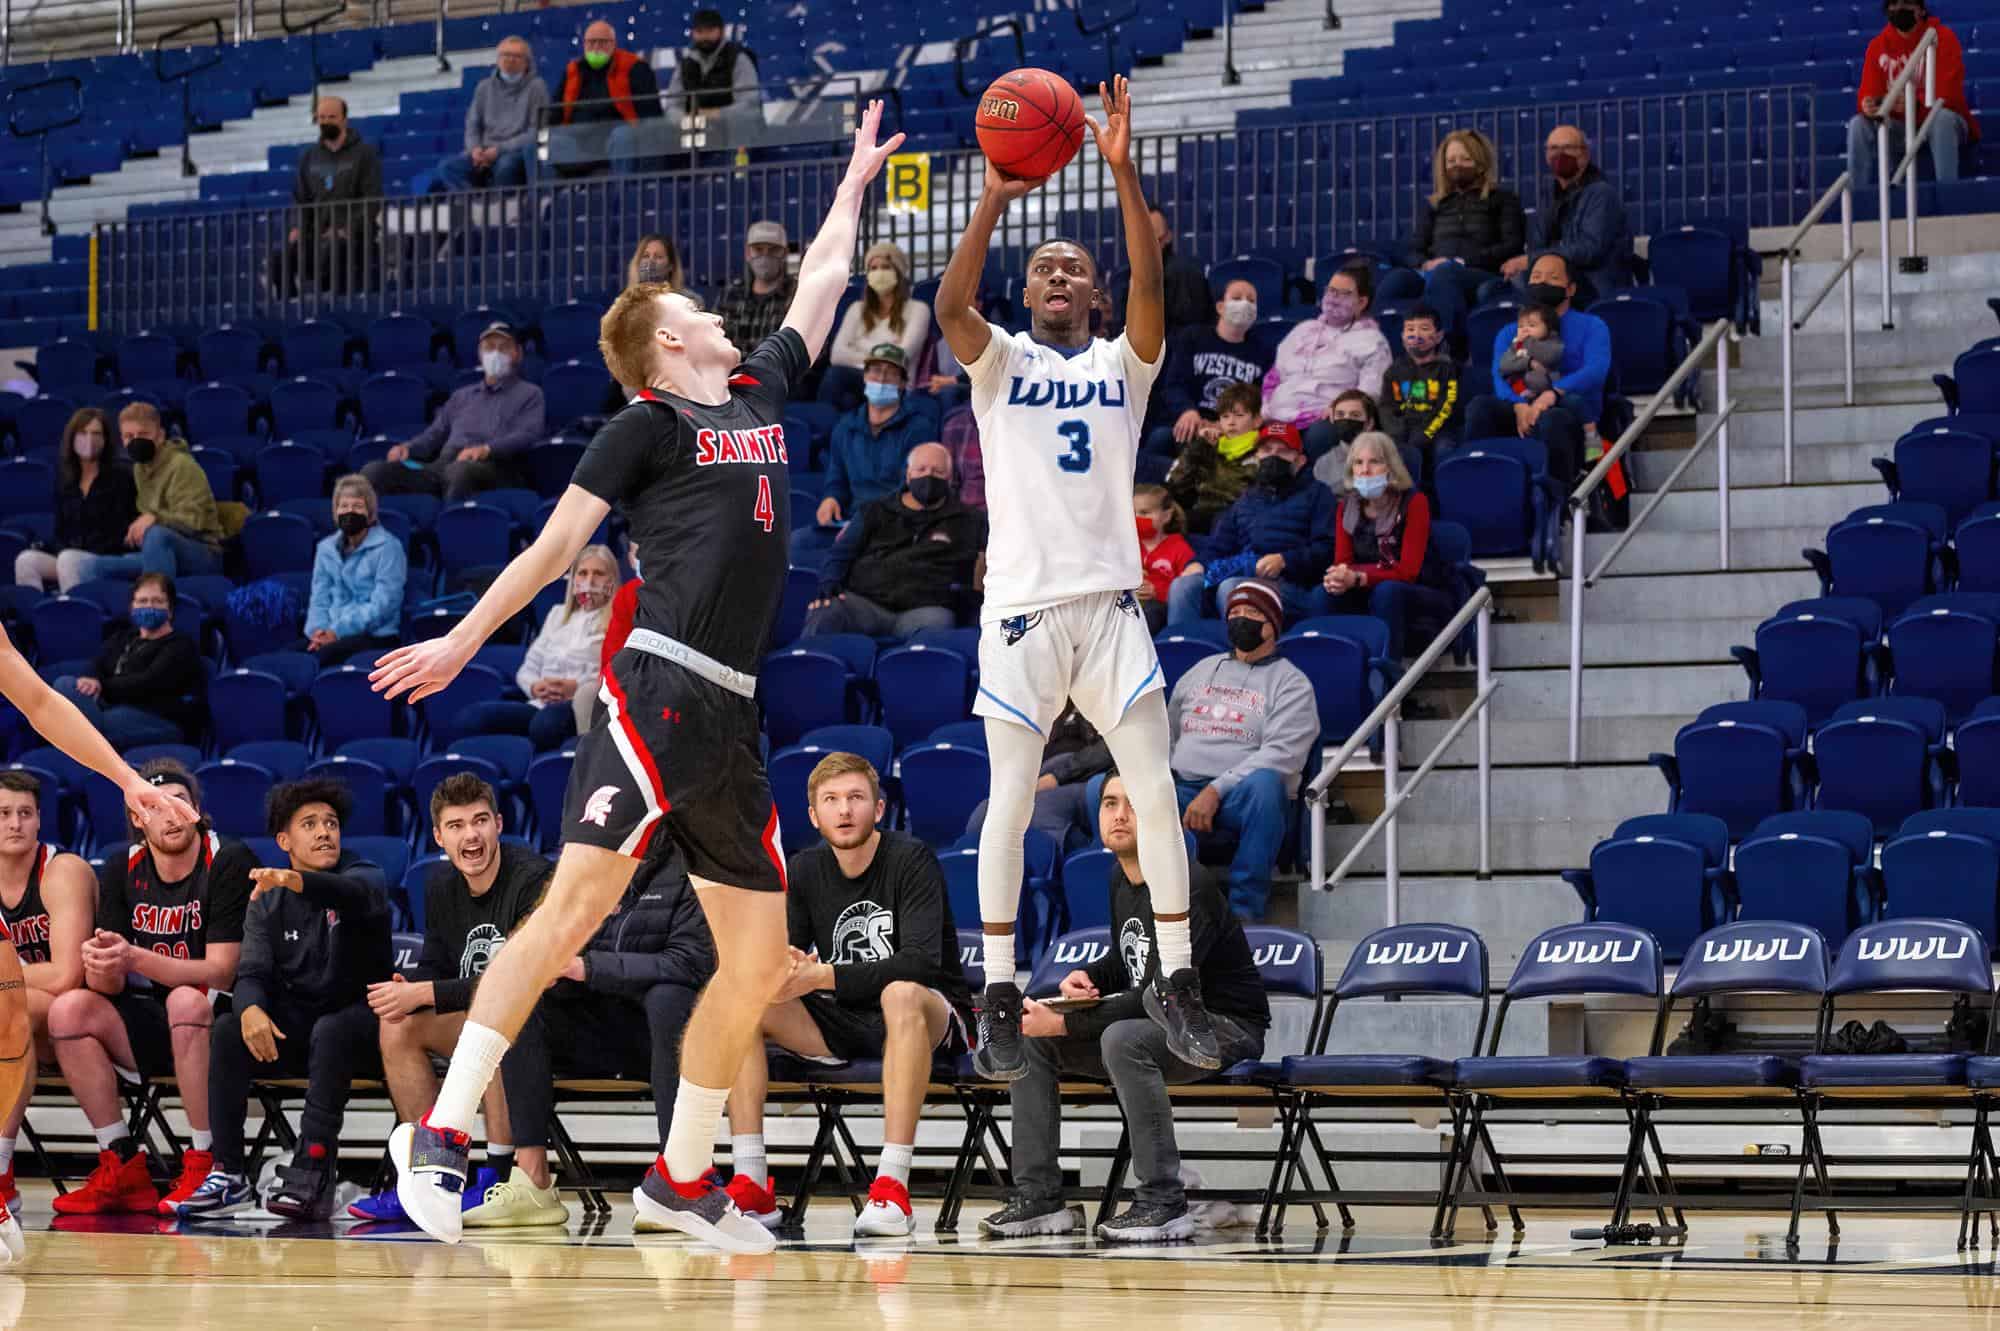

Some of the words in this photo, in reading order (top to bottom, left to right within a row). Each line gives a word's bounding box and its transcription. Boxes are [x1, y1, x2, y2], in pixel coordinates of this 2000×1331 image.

[982, 97, 1019, 122] Wil
[894, 164, 922, 200] B
[1008, 376, 1124, 408] WWU
[696, 424, 788, 466] SAINTS
[1056, 419, 1092, 474] 3
[754, 475, 774, 532] 4
[10, 913, 50, 946] INTS
[1366, 941, 1469, 964] WWU
[1537, 939, 1642, 963] WWU
[1703, 938, 1811, 962] WWU
[1857, 937, 1969, 960] WWU
